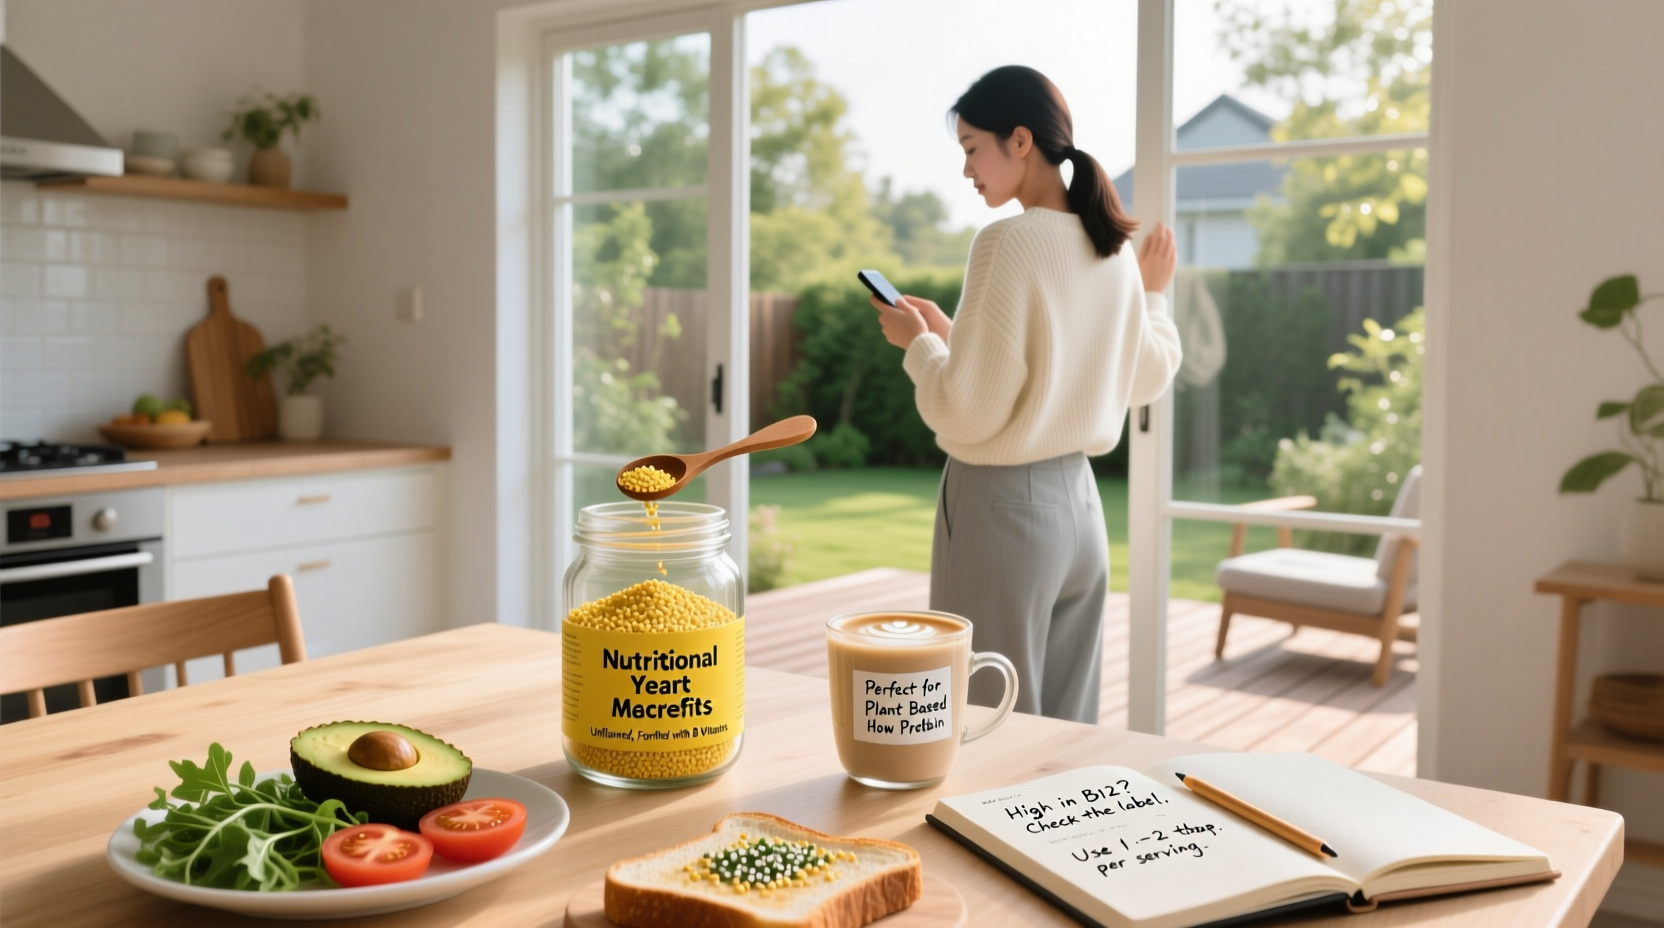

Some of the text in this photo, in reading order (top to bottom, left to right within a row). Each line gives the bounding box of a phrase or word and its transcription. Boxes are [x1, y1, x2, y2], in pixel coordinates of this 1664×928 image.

[602, 645, 718, 671] Nutritional
[630, 675, 691, 695] Yeart
[865, 678, 941, 698] Perfect for
[865, 694, 947, 716] Plant Based
[867, 719, 894, 734] How
[1005, 779, 1131, 820] High in B12?
[1026, 792, 1169, 834] Check the label.
[1071, 846, 1113, 862] Use
[1097, 859, 1126, 877] per
